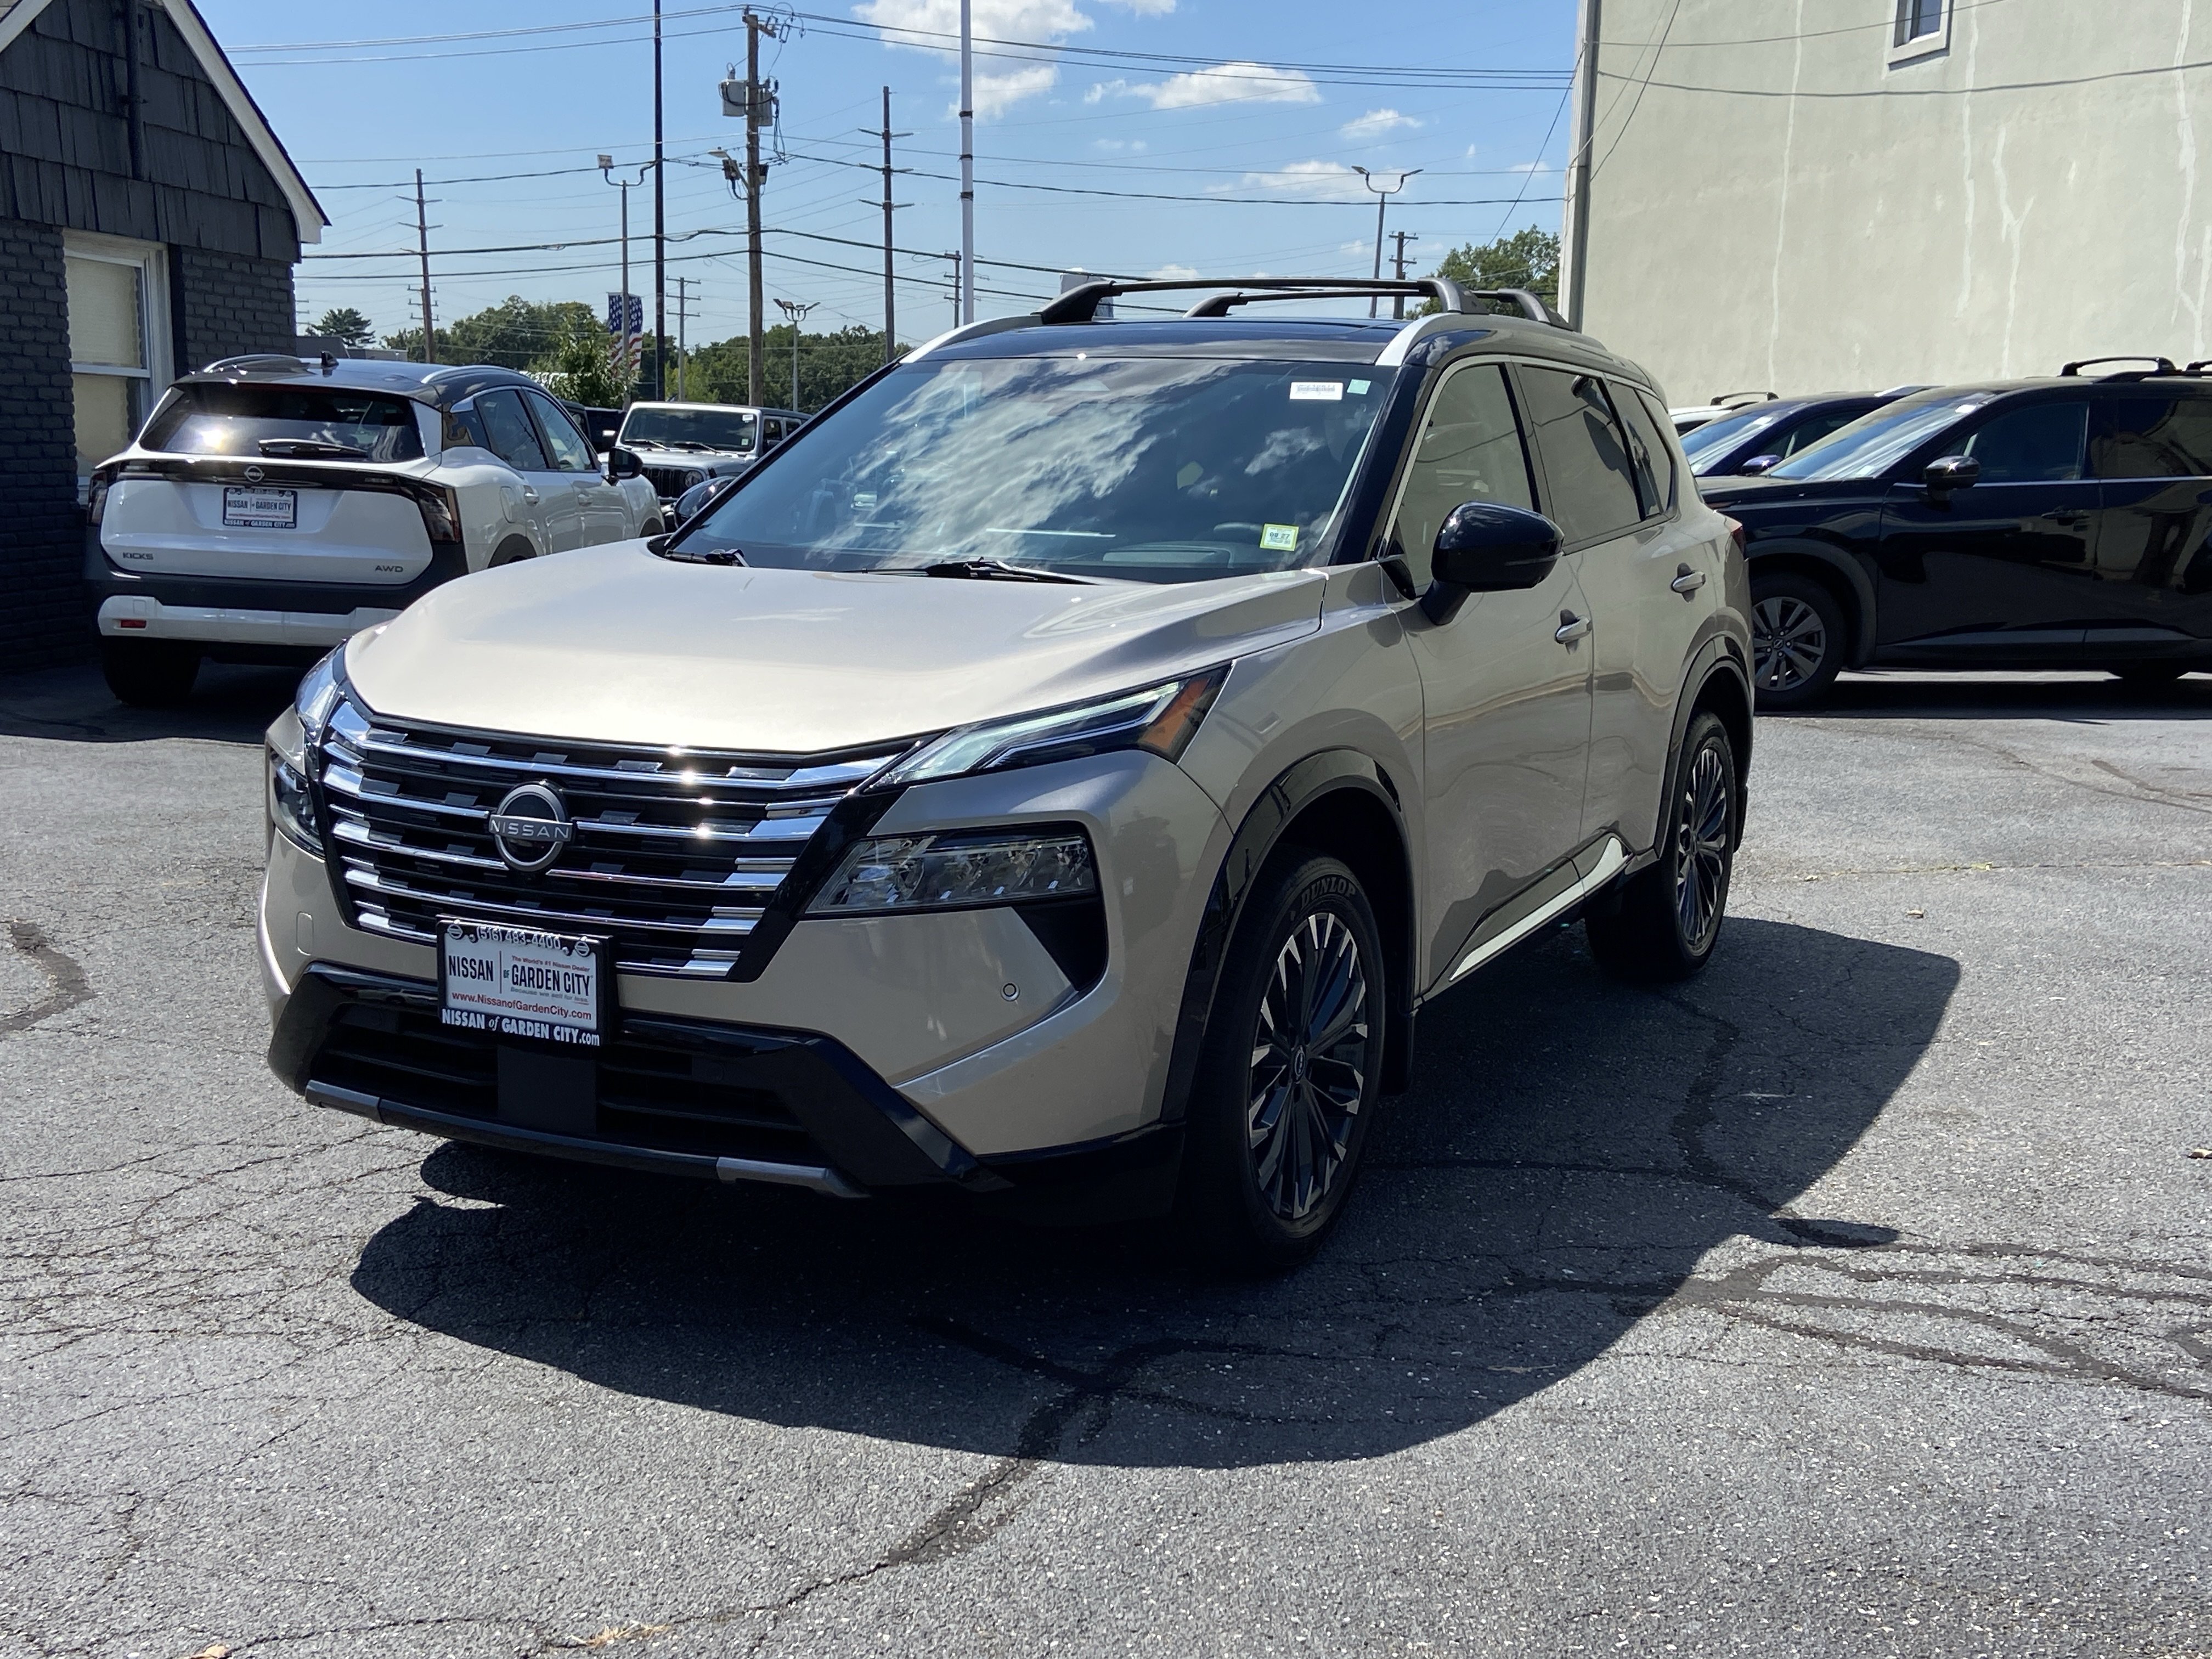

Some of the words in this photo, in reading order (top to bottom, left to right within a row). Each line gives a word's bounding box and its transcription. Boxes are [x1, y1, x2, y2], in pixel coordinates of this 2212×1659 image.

[256, 501, 277, 510] GARDEN
[278, 503, 291, 511] CITY
[123, 552, 154, 560] KICKS
[375, 565, 403, 573] AWD
[490, 819, 569, 839] NISSAN
[1300, 877, 1356, 911] DUNLOP
[476, 926, 503, 942] (516)
[505, 929, 561, 950] 483-4400
[448, 955, 494, 982] NISSAN
[503, 969, 510, 979] OF
[511, 963, 561, 992] GARDEN
[563, 971, 590, 996] CITY
[452, 991, 591, 1020] www.NissanofGardenCity.com
[442, 1008, 485, 1029] NISSAN
[488, 1015, 500, 1031] of
[501, 1017, 549, 1039] GARDEN
